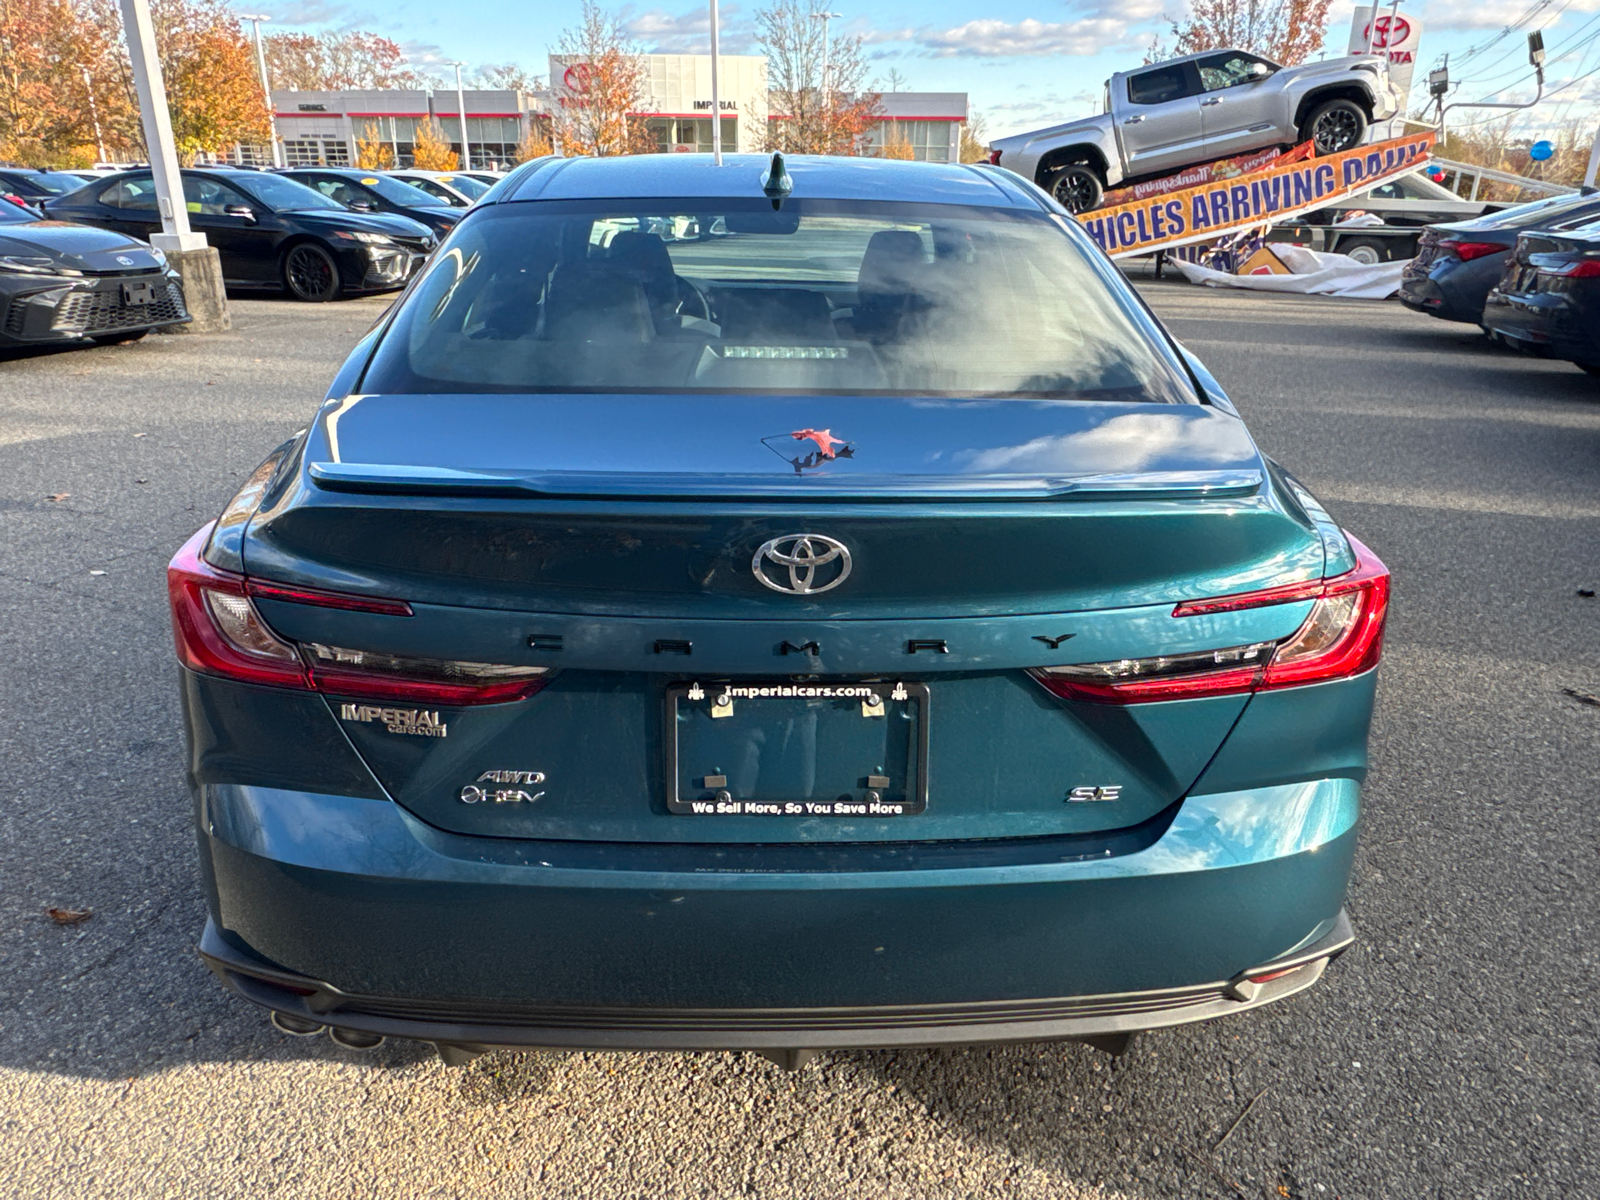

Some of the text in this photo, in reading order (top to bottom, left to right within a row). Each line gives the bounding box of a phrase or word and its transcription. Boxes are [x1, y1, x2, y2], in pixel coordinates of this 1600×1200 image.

[693, 100, 738, 110] IMPRIAL
[1191, 165, 1335, 231] ARRIVING
[724, 684, 872, 698] Imperialcars.com
[341, 703, 447, 728] IMPERIAL
[387, 722, 447, 738] cars.com
[477, 770, 545, 785] AWD
[1066, 784, 1123, 803] SE
[692, 802, 903, 816] We Sell More, So You Save More
